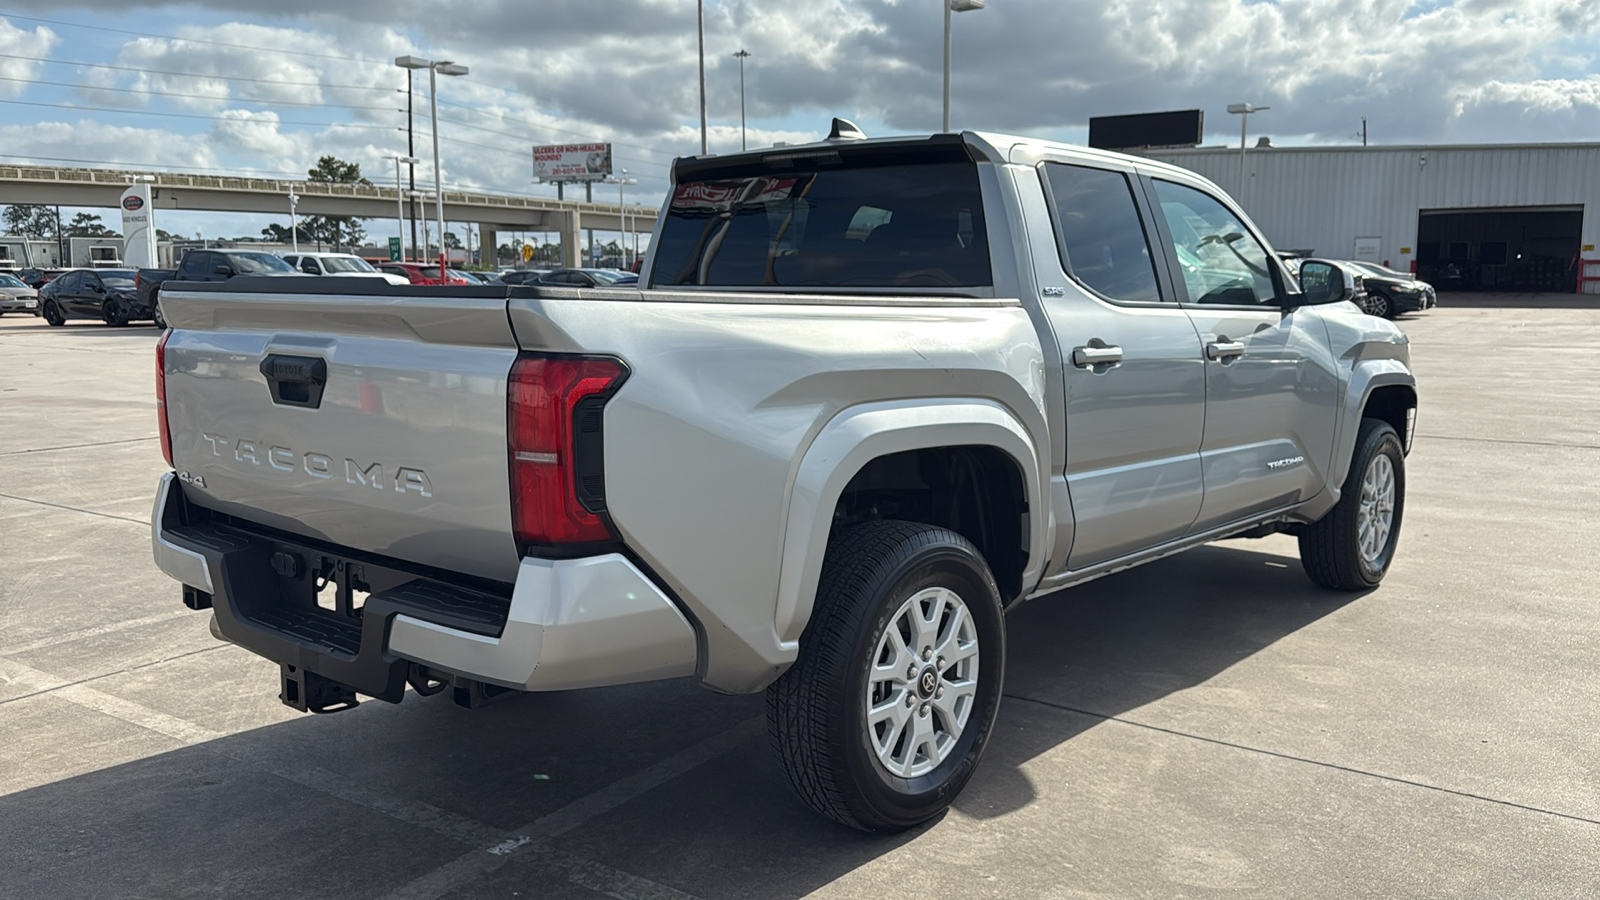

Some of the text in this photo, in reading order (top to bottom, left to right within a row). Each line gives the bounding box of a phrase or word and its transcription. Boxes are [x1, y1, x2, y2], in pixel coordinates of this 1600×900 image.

[534, 146, 555, 154] ULCERS
[566, 144, 605, 153] NON-HEALING
[534, 154, 562, 162] WOUNDS?
[275, 363, 304, 376] TOYOTA
[203, 432, 433, 498] TACOMA
[1266, 455, 1304, 470] TACOMA
